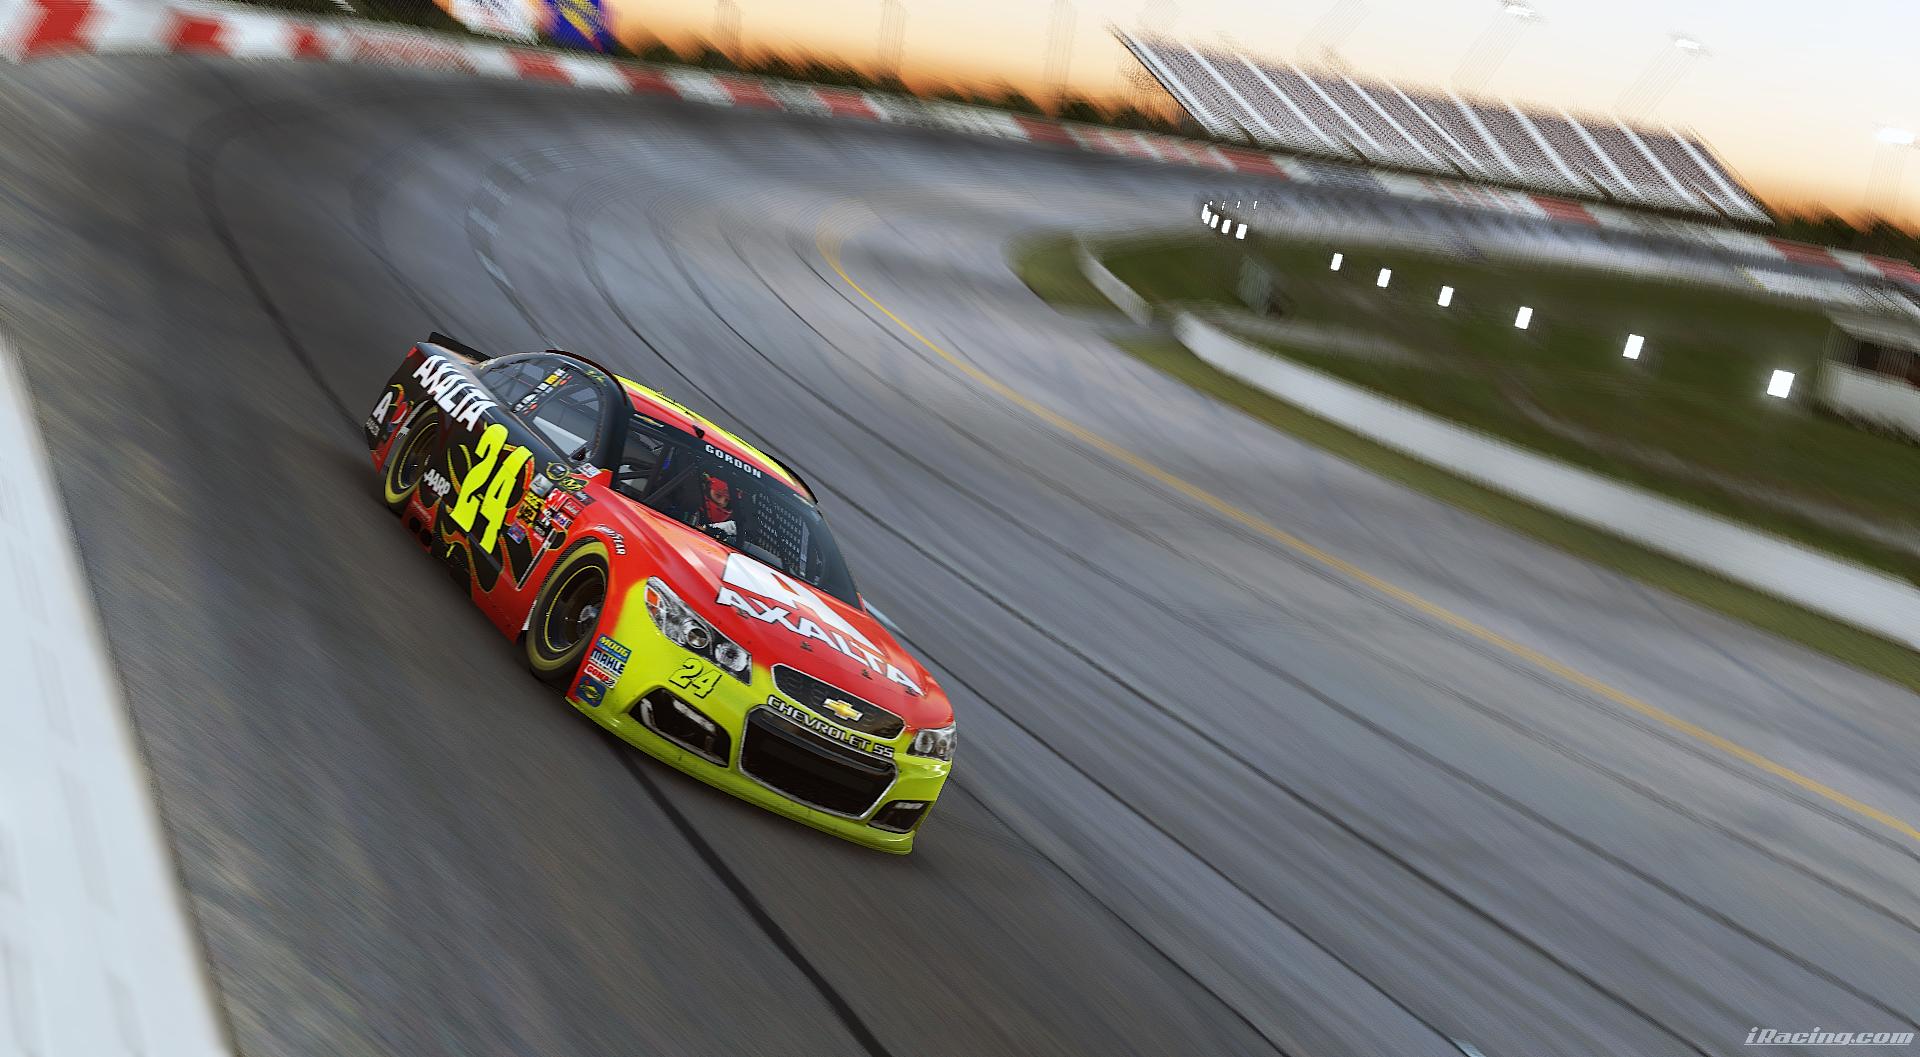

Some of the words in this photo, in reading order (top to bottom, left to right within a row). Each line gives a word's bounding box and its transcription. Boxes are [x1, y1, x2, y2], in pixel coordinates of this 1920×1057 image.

[412, 355, 498, 432] AXALTA
[424, 468, 451, 497] AARP
[705, 444, 761, 479] GORDON
[450, 423, 533, 554] 24
[591, 648, 626, 675] MAHLE
[716, 586, 926, 697] AXALTA
[669, 657, 722, 699] 24
[767, 695, 871, 750] CHEVROLET
[872, 743, 895, 759] SS
